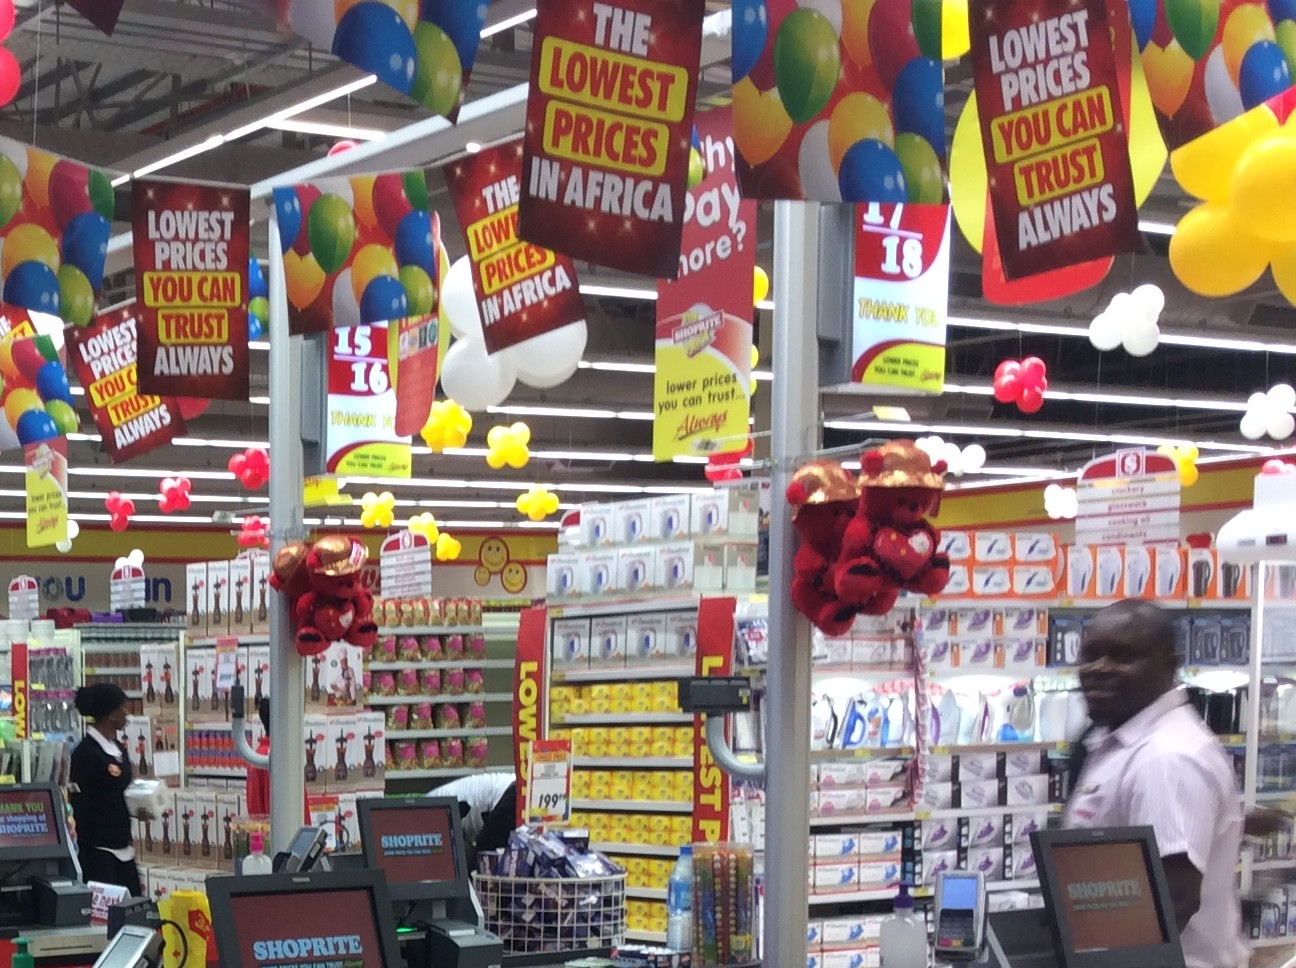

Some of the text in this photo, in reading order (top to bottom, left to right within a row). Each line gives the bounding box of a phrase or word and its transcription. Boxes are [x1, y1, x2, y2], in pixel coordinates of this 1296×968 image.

[594, 2, 652, 56] THE
[989, 9, 1089, 74] LOWEST
[550, 48, 675, 112] LOWEST
[1001, 51, 1091, 113] PRICES
[551, 109, 658, 168] PRICES
[998, 93, 1106, 155] YOU CAN
[700, 135, 736, 173] hy
[1019, 144, 1097, 199] TRUST
[482, 175, 519, 214] THE
[529, 157, 673, 223] IN AFRICA
[148, 210, 234, 240] LOWEST
[1018, 183, 1117, 250] ALWAYS
[155, 241, 228, 270] PRICES
[485, 248, 546, 289] PRICES
[881, 236, 923, 278] 18
[149, 277, 235, 302] YOU CAN
[482, 266, 571, 326] IN AFRICA
[858, 298, 910, 323] THANK
[79, 318, 136, 363] LOWEST
[161, 313, 224, 339] TRUST
[674, 315, 722, 341] SHOPRITE
[334, 327, 372, 356] 15
[154, 346, 234, 376] ALWAYS
[95, 376, 126, 403] YOU
[350, 362, 387, 394] 16
[666, 372, 737, 394] lower prices
[331, 410, 376, 428] THANK
[658, 399, 678, 414] you
[682, 395, 703, 407] can
[114, 404, 171, 450] ALWAYS
[676, 409, 728, 436] Always
[700, 656, 724, 812] LEST
[25, 802, 44, 812] YOU
[538, 794, 559, 809] 199
[381, 833, 443, 848] SHOPRITE
[1067, 879, 1142, 899] SHOPRITE
[253, 935, 363, 960] SHOPRITE
[326, 961, 342, 968] TRUST
